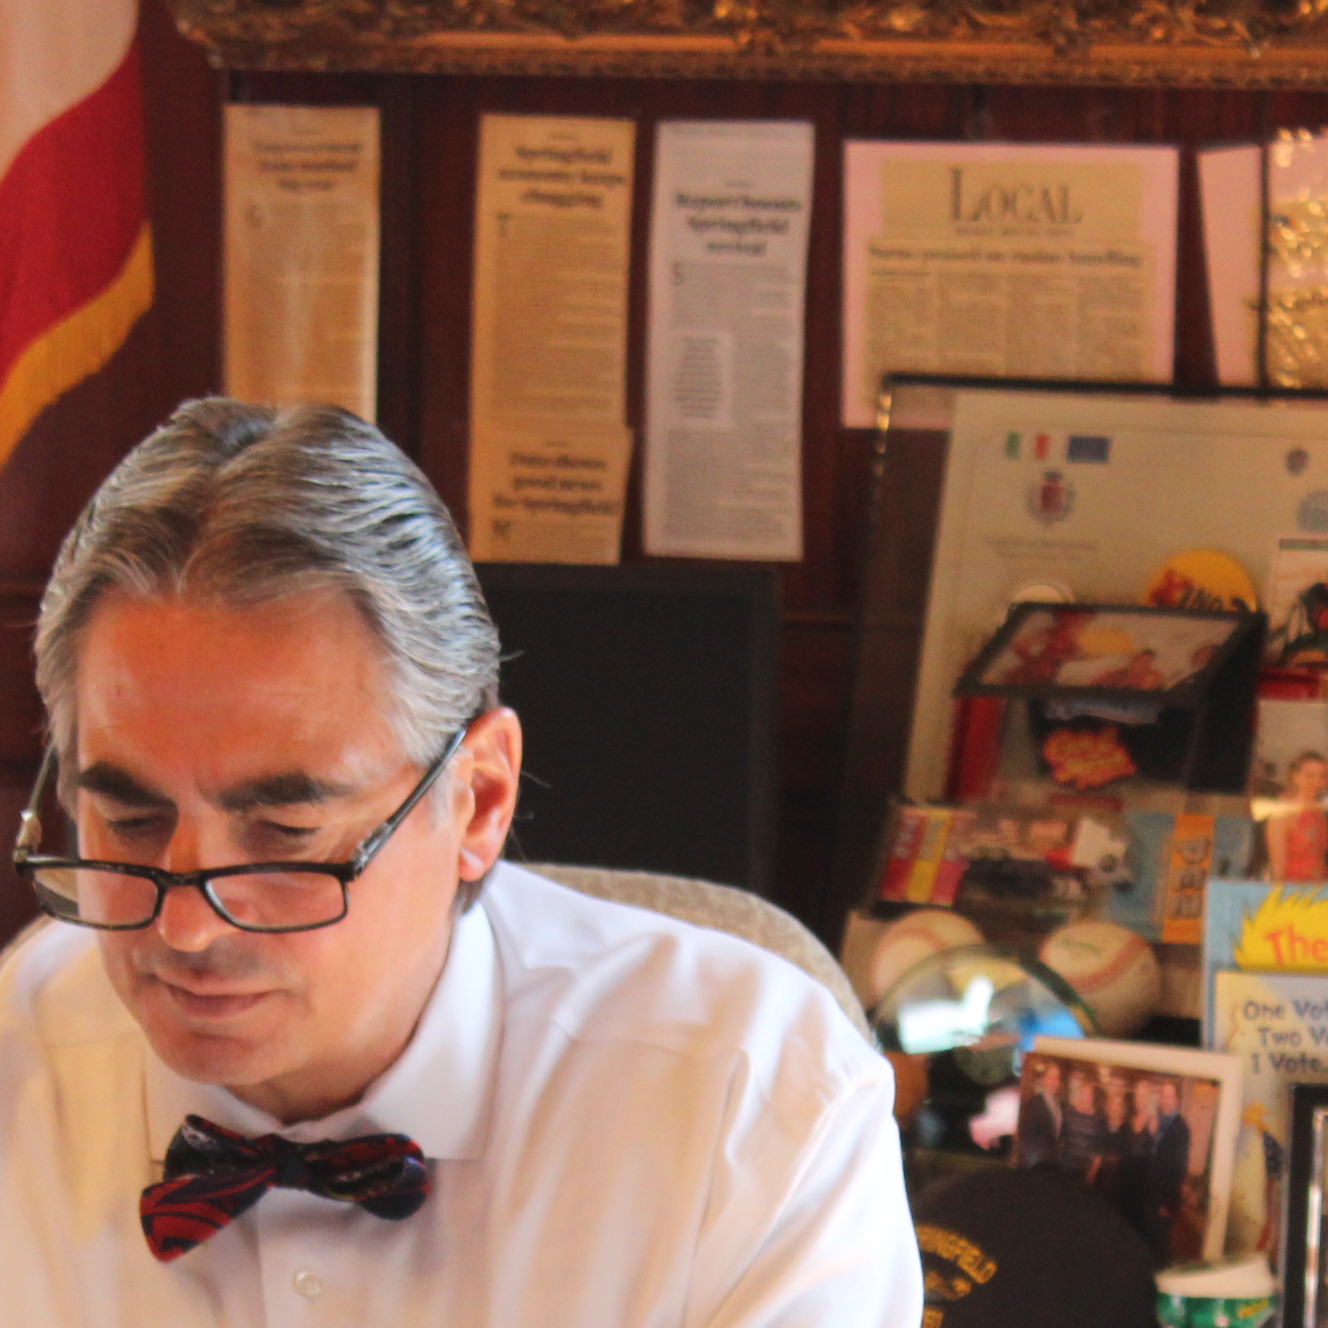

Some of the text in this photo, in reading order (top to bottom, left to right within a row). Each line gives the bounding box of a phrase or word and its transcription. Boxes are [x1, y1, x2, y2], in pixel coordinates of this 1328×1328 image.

[1244, 999, 1287, 1023] One
[1258, 1026, 1304, 1047] Two
[1251, 1055, 1262, 1075] I
